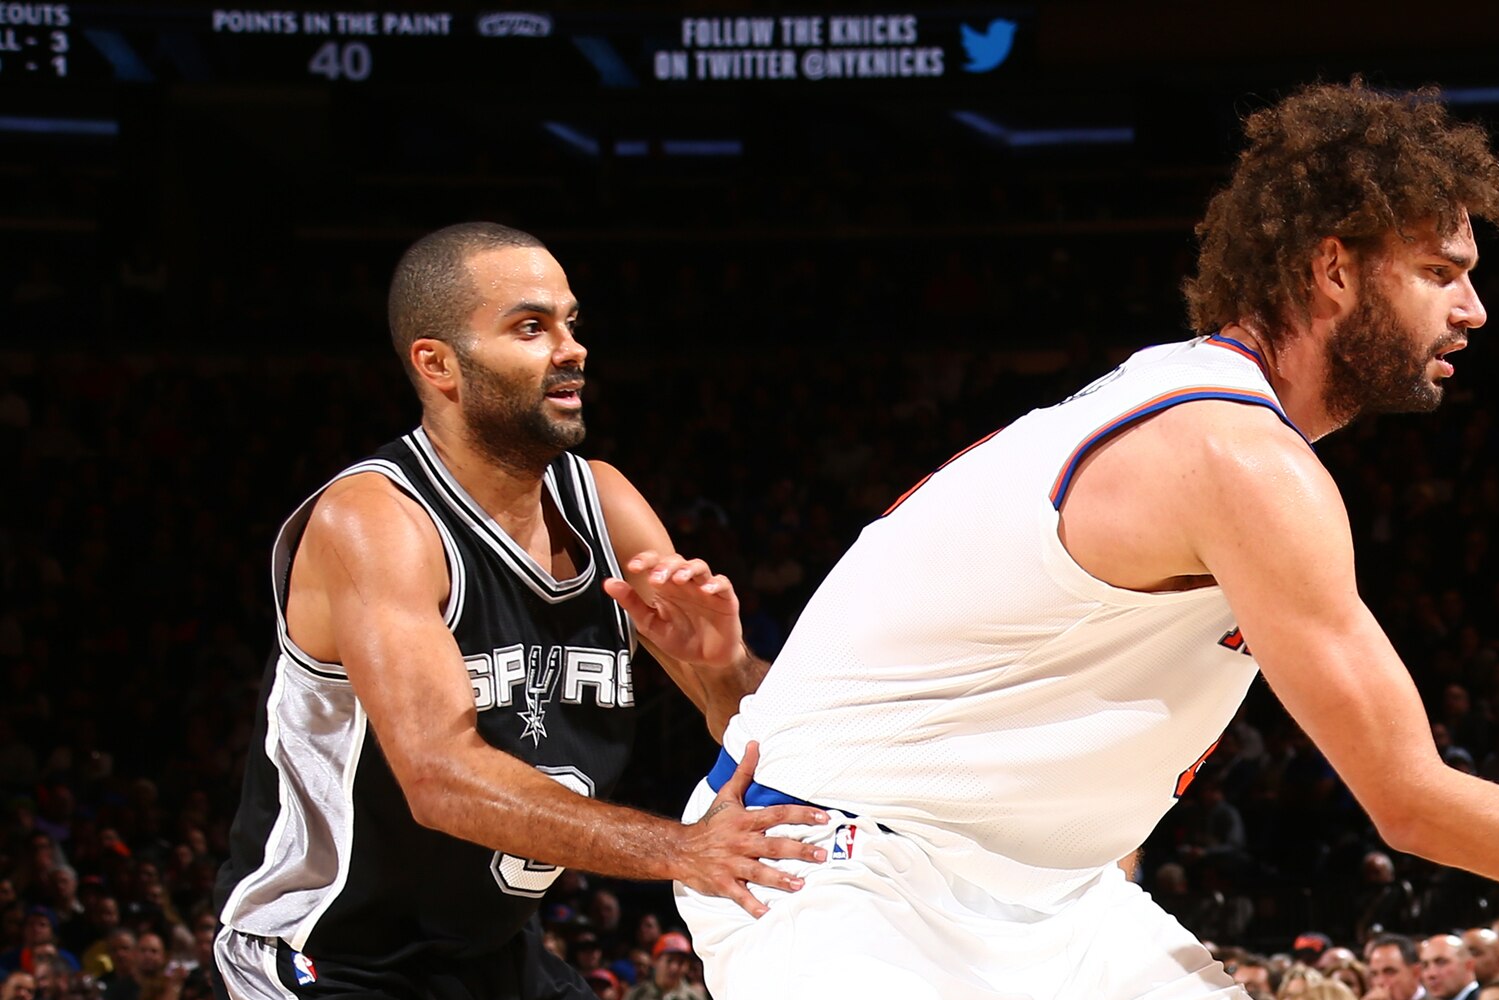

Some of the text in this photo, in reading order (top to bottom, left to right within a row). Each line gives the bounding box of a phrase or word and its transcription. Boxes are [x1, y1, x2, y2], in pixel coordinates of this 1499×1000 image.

[211, 10, 297, 34] POINTS
[303, 13, 330, 35] IN
[335, 13, 378, 35] THE
[383, 13, 452, 35] PAINT
[681, 15, 918, 48] FOLLOW THE KNICKS
[50, 30, 69, 53] 3
[50, 55, 68, 77] 1
[307, 41, 372, 81] 40
[654, 47, 945, 80] ON TWITTER @NYKNICKS
